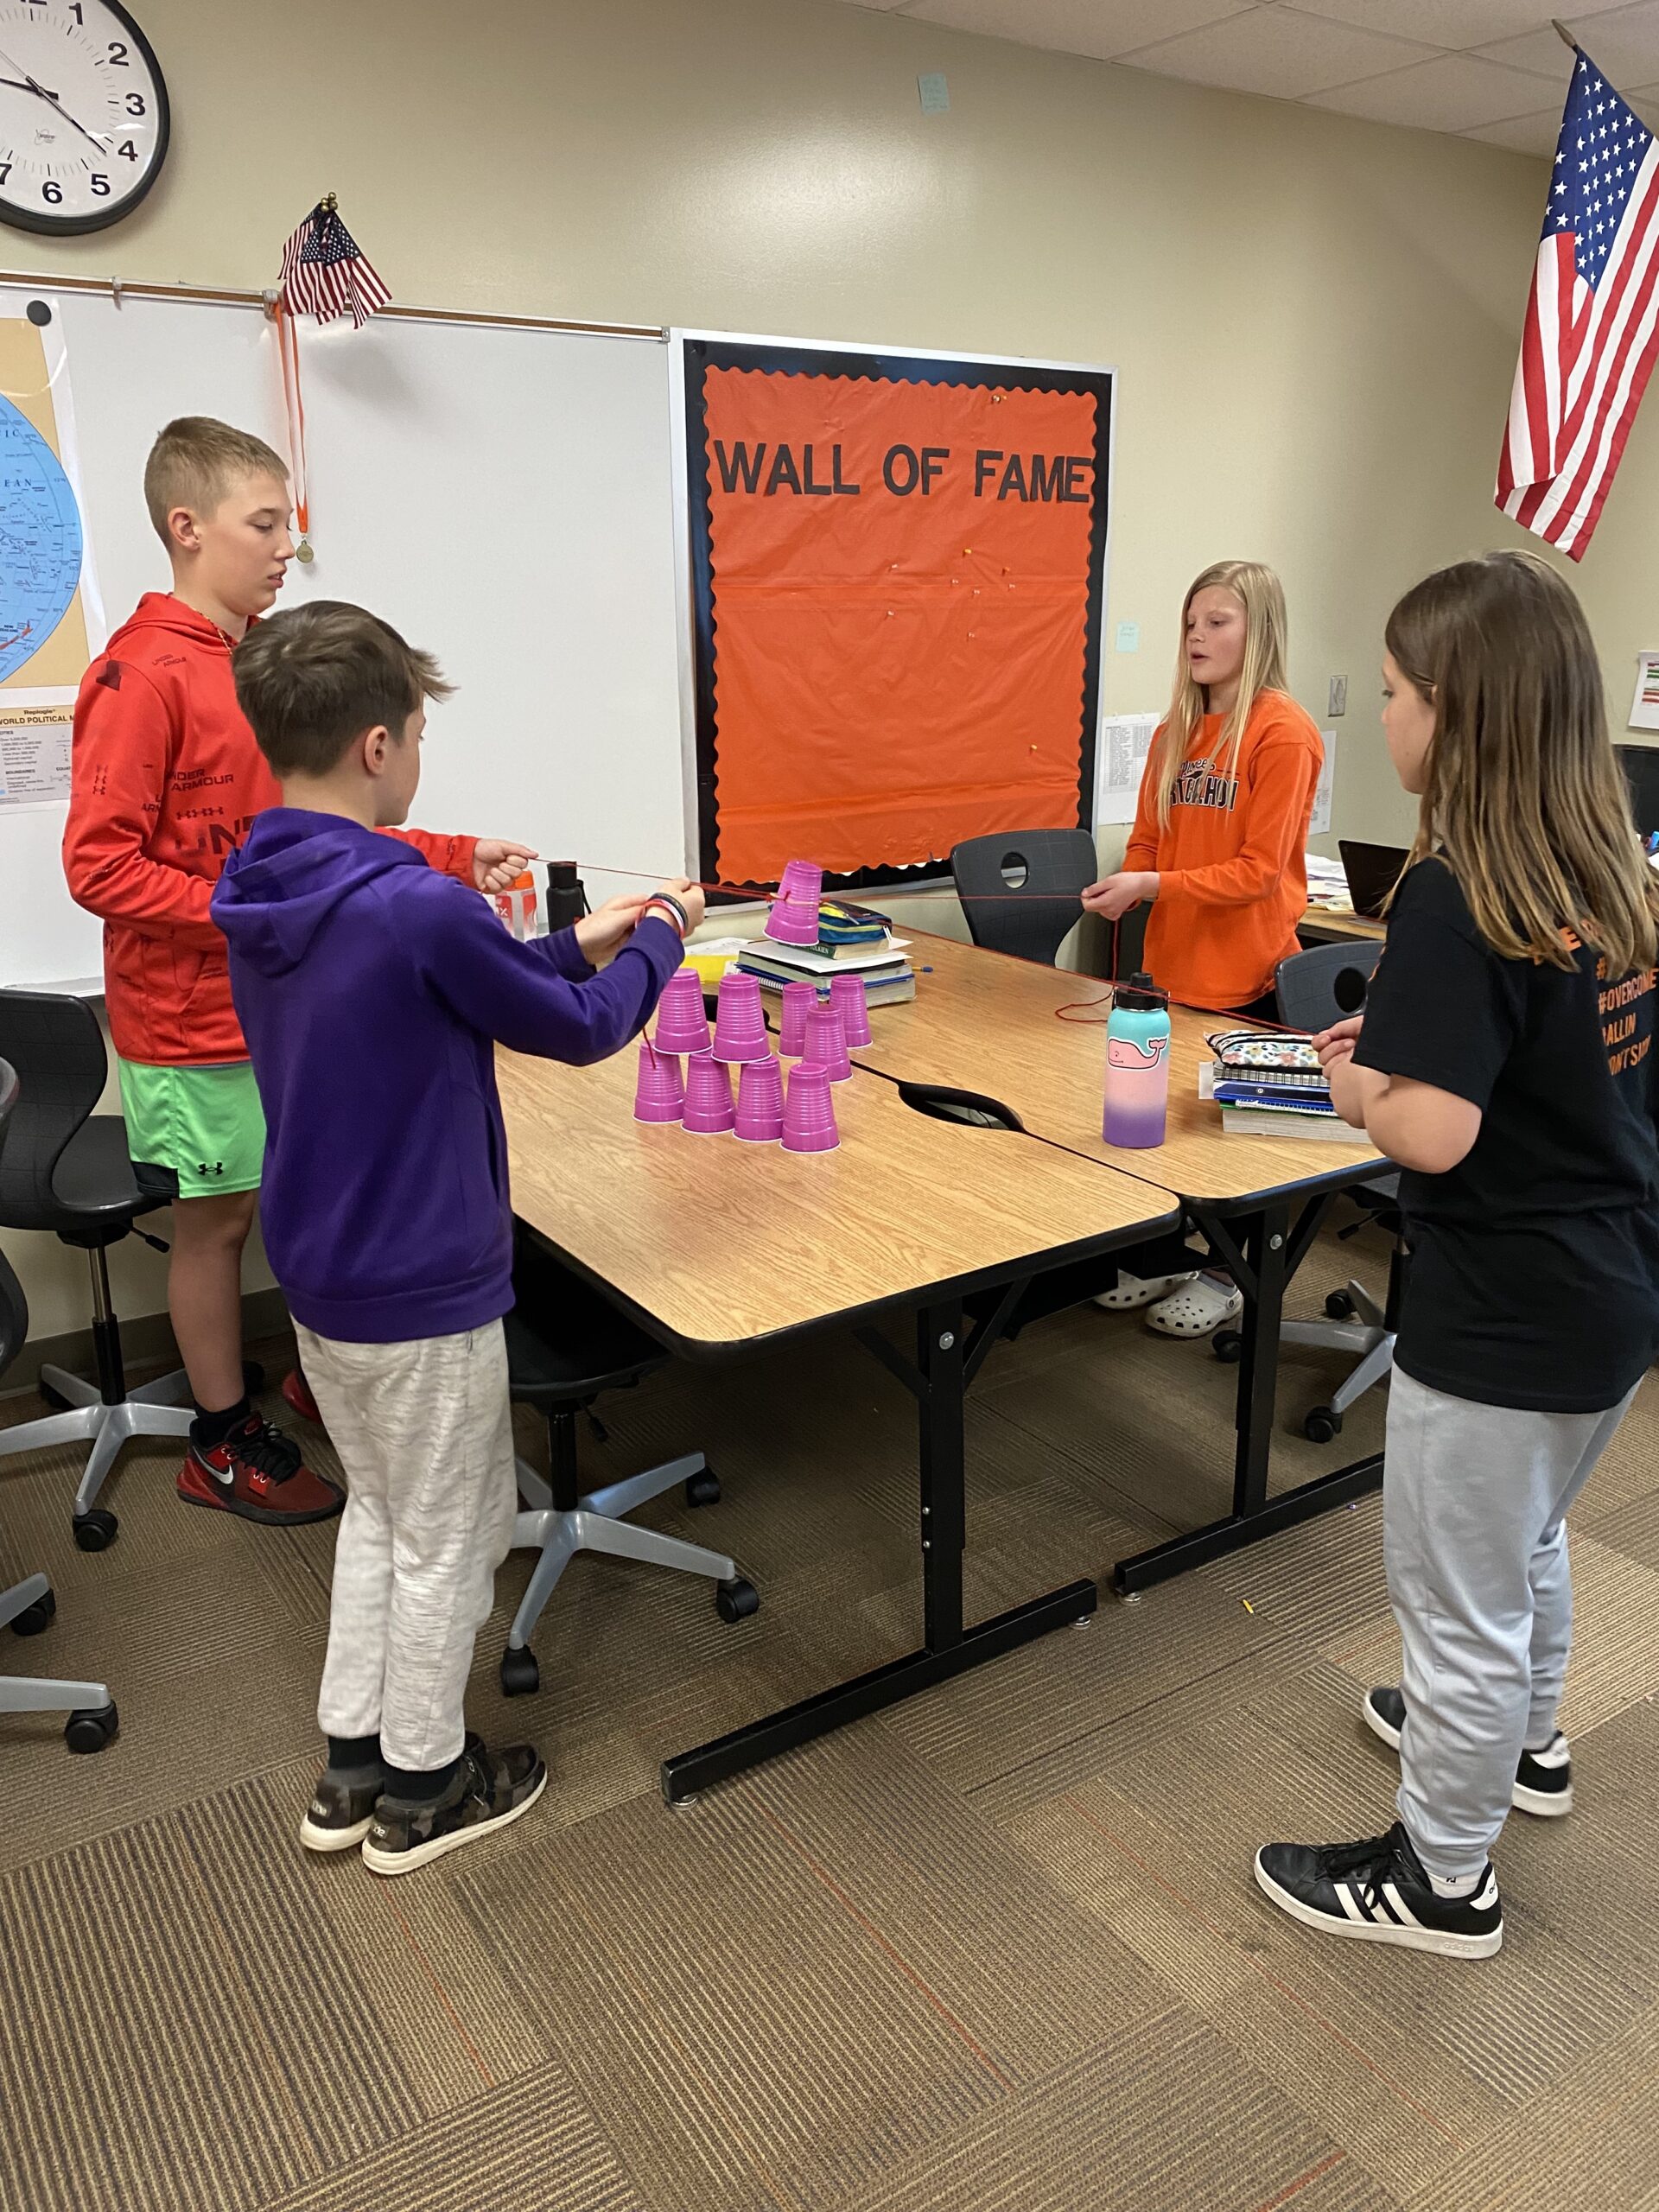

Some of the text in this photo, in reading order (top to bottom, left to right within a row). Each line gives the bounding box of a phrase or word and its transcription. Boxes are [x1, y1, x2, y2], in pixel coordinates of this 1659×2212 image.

[68, 3, 84, 26] 1
[107, 41, 130, 67] 2
[125, 92, 146, 116] 3
[118, 140, 138, 162] 4
[41, 181, 63, 204] 6
[91, 174, 111, 195] 5
[714, 439, 1093, 503] WALL OF FAME
[28, 715, 67, 723] POLITICAL
[171, 773, 235, 792] ARMOUR
